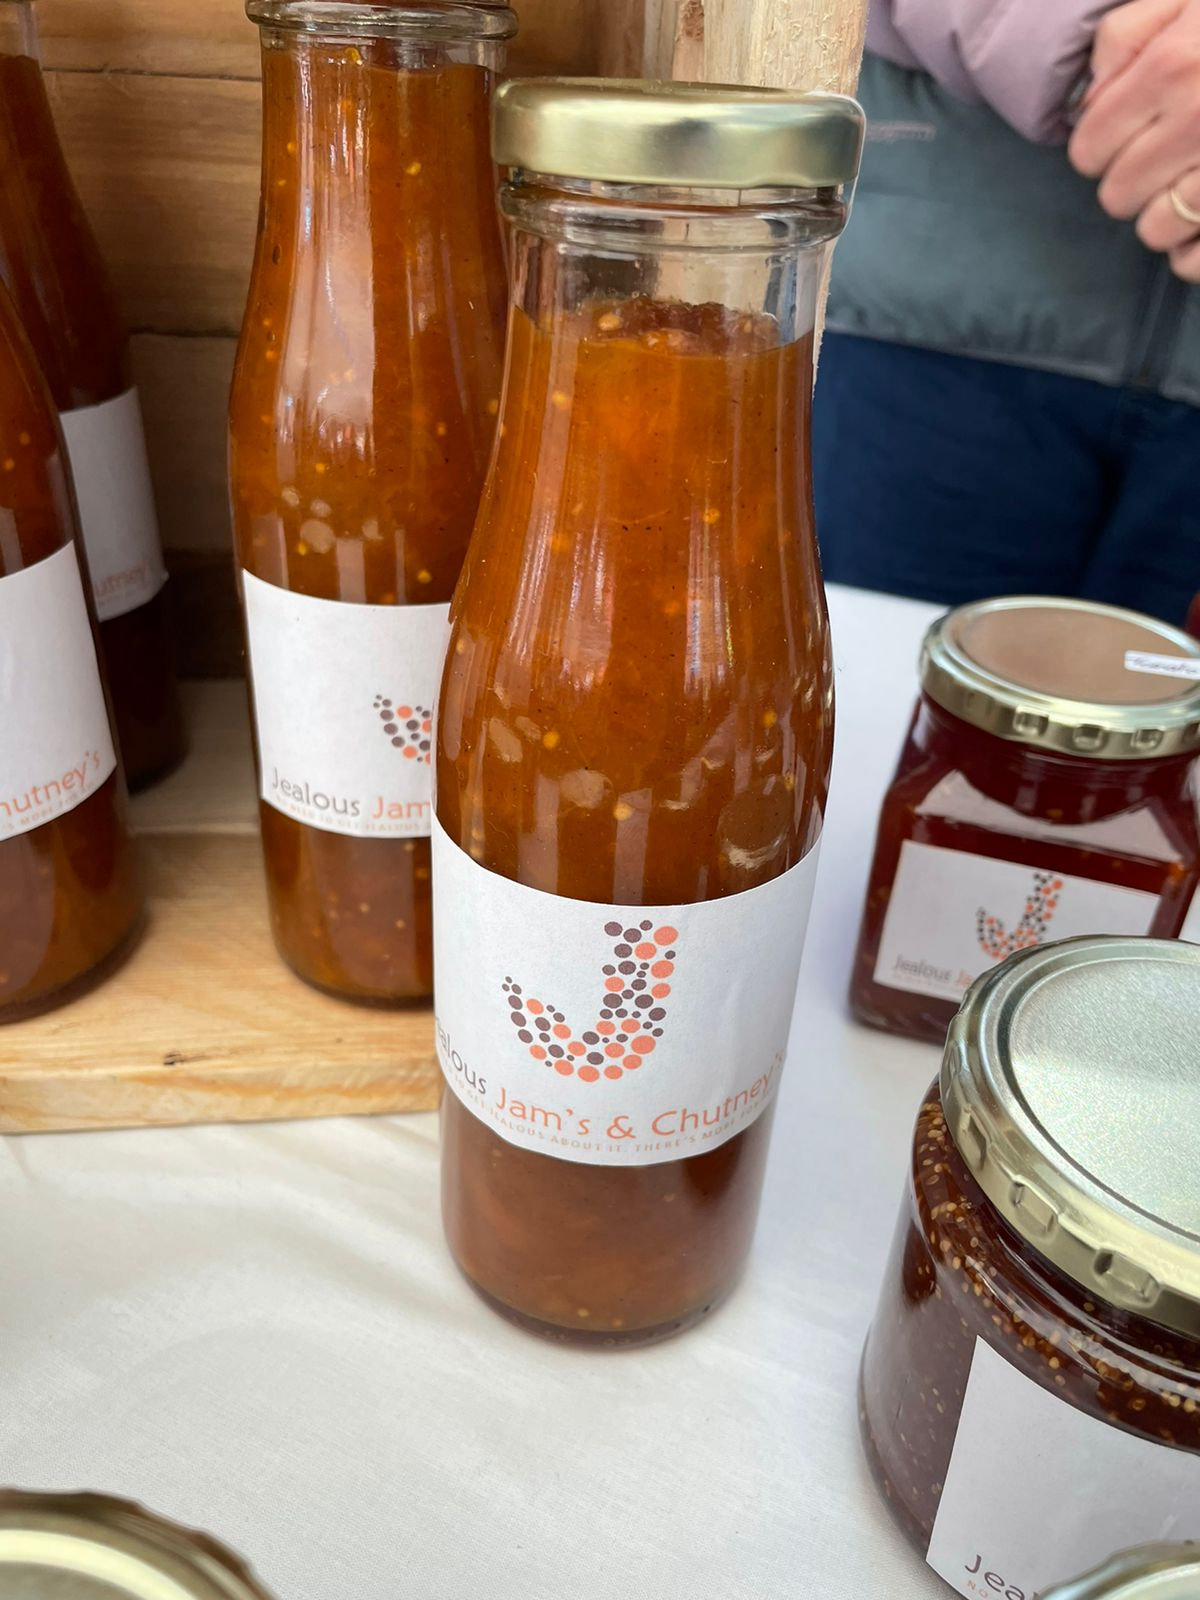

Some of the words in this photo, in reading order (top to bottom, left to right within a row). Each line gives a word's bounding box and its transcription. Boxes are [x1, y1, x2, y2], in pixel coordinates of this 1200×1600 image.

[272, 767, 361, 816] Jealous
[372, 796, 431, 819] Jam
[496, 1087, 590, 1135] Jam's
[606, 1115, 636, 1139] &
[550, 1135, 601, 1152] ABOUT
[964, 1554, 1037, 1600] Jea
